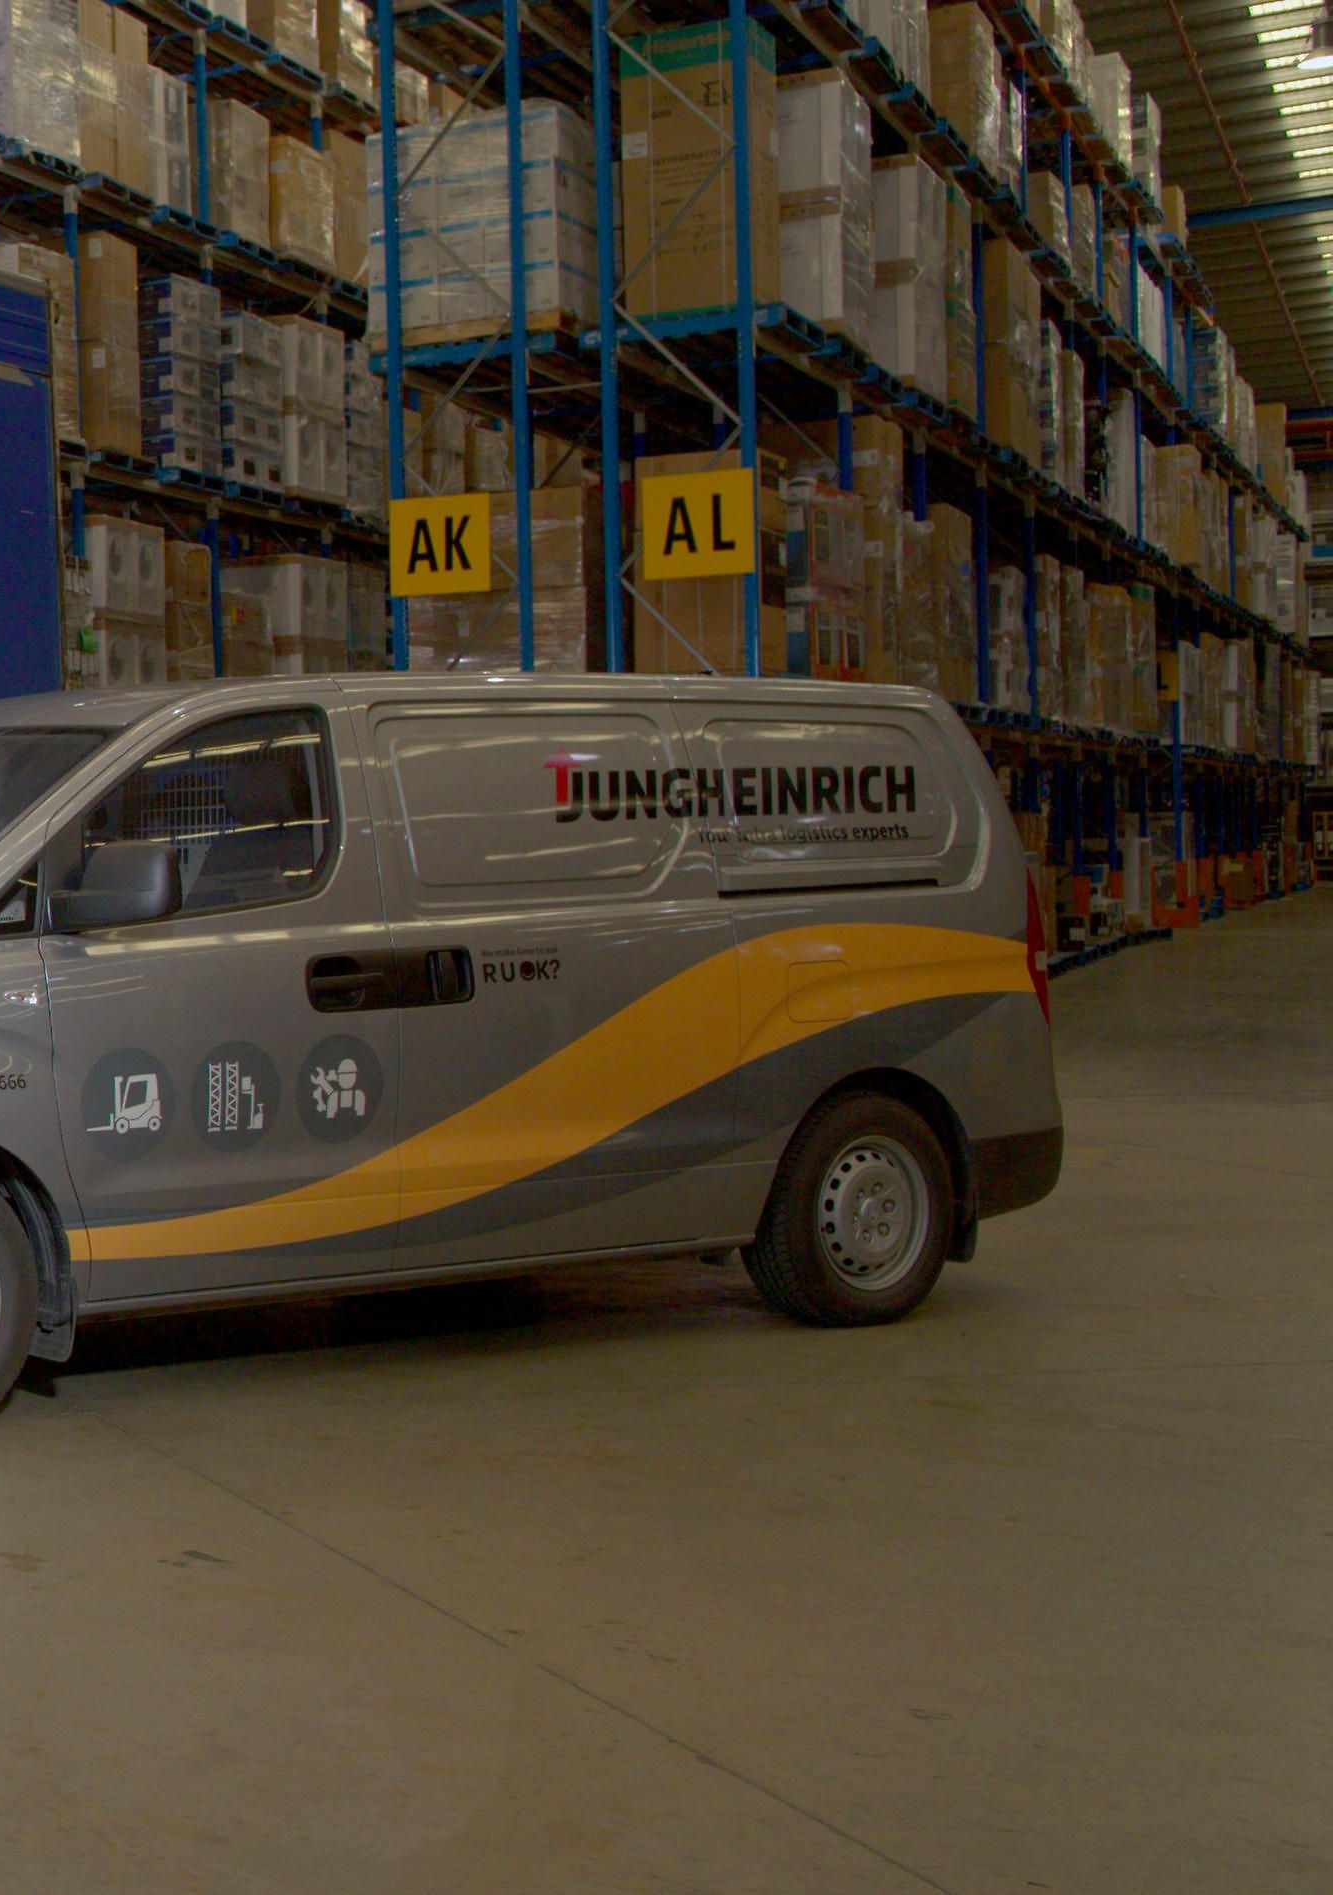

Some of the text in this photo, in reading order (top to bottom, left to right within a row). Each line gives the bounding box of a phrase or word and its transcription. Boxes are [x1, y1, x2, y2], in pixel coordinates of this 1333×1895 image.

[407, 515, 471, 574] AK
[663, 494, 735, 555] AL
[555, 764, 917, 824] JUNGHEINRICH
[697, 827, 735, 844] You
[852, 823, 910, 842] experts
[483, 963, 497, 984] R
[500, 961, 515, 982] U
